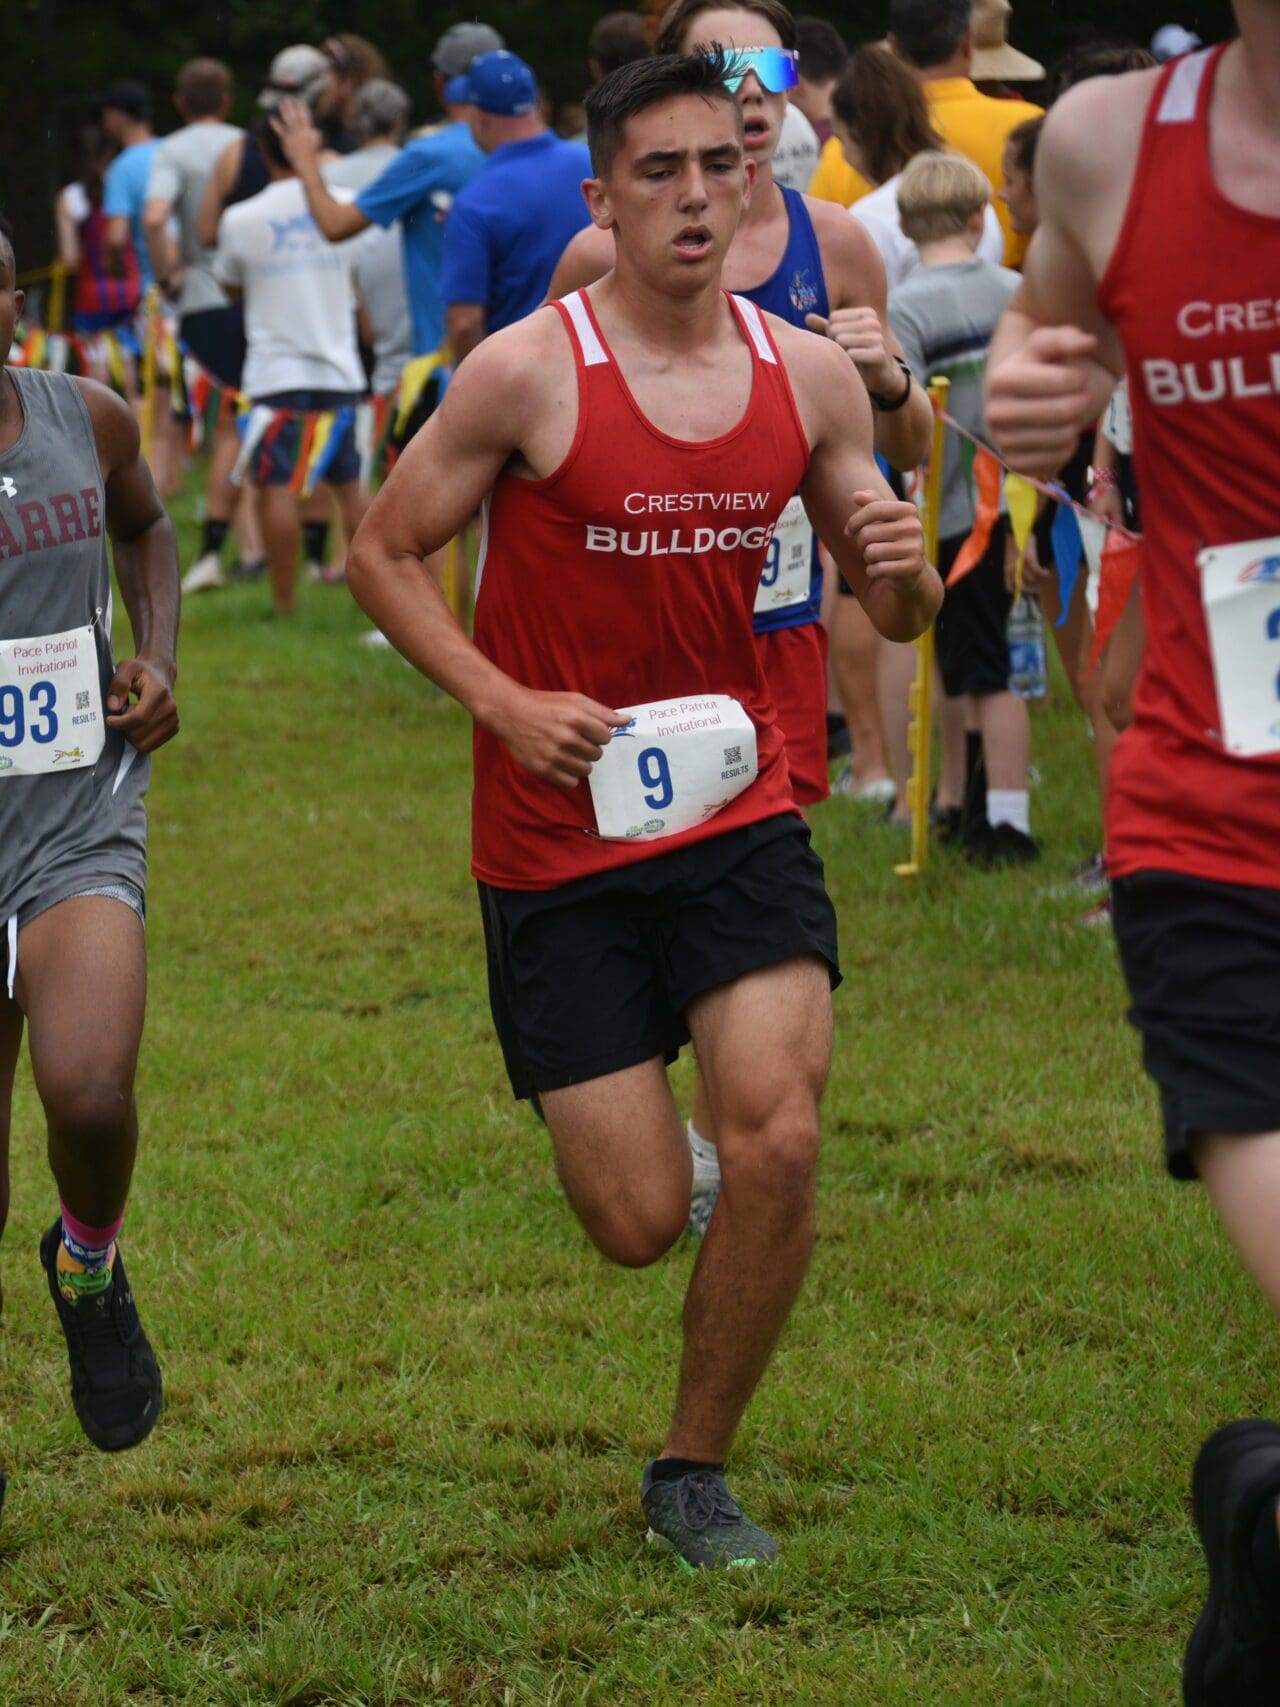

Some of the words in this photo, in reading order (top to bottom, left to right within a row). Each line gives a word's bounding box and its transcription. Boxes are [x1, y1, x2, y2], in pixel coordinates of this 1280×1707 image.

[1176, 299, 1280, 338] CRE
[624, 492, 770, 514] CRESTVIEW
[13, 646, 42, 659] Pace
[45, 639, 78, 653] Patriot
[18, 656, 78, 676] Invitational
[72, 712, 97, 726] RESULTS
[649, 707, 678, 720] Pace
[679, 700, 718, 714] Patriot
[657, 714, 722, 737] Invitational
[637, 747, 674, 810] 9
[721, 765, 749, 782] RESULTS
